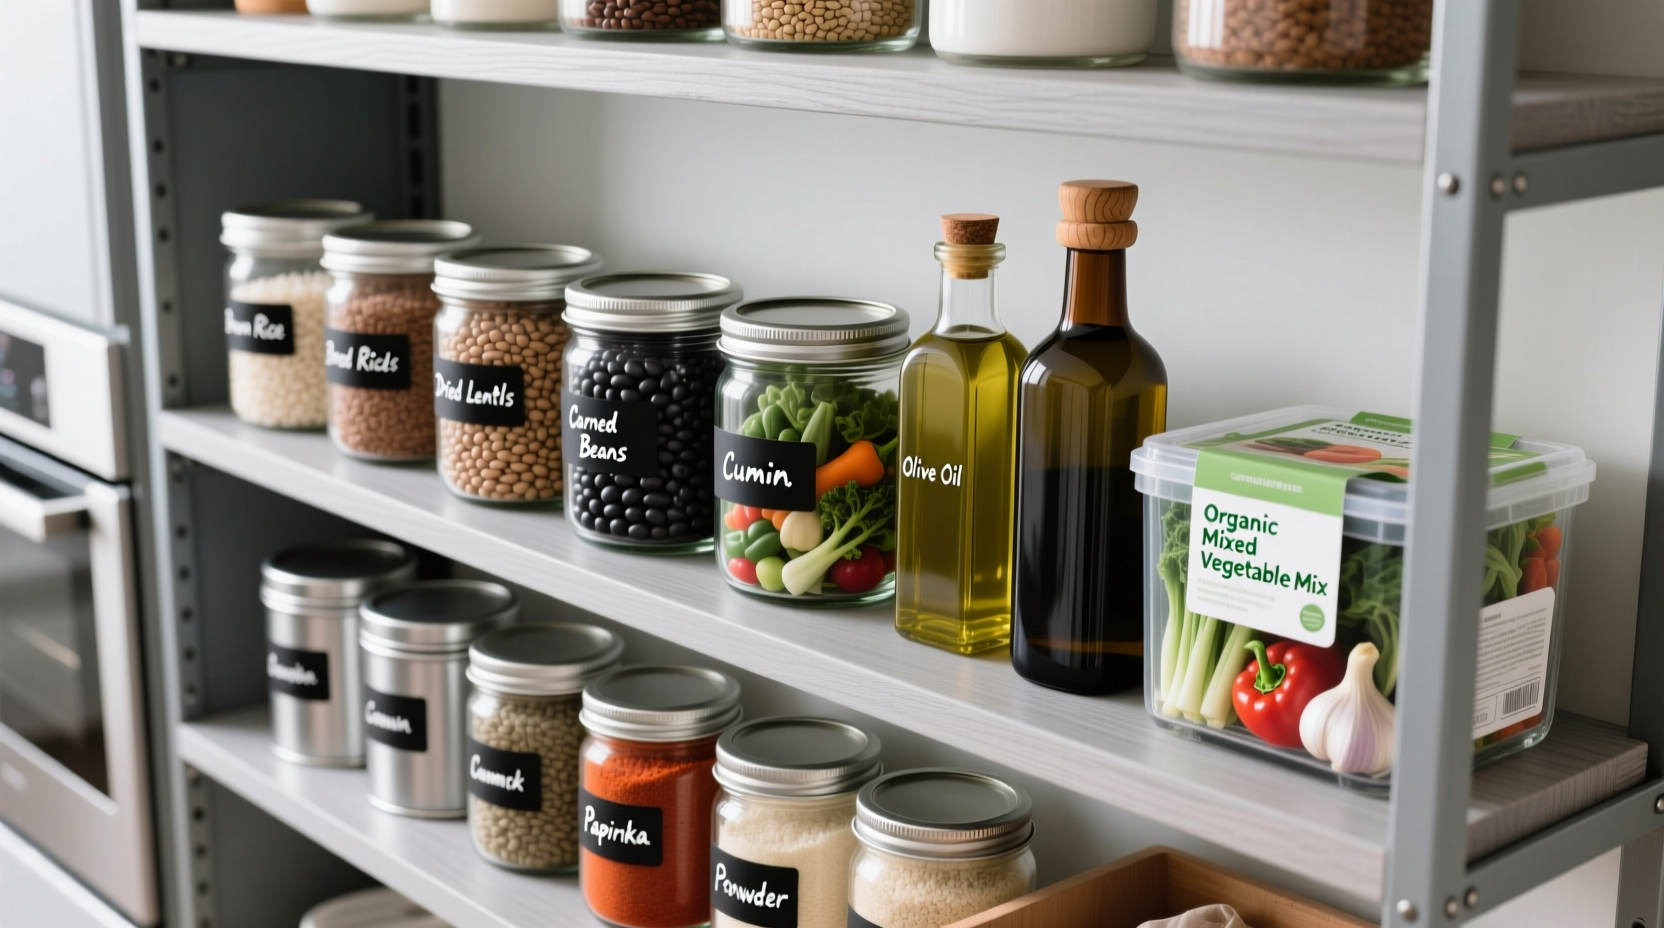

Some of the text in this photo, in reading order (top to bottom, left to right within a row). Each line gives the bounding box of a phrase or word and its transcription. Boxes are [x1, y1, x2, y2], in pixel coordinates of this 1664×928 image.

[579, 433, 628, 462] Beans
[902, 455, 963, 487] Olive Oil
[1203, 503, 1279, 536] Organic
[1202, 527, 1258, 556] Mixed
[1201, 550, 1291, 588] Vegetable
[1294, 571, 1328, 597] Mix
